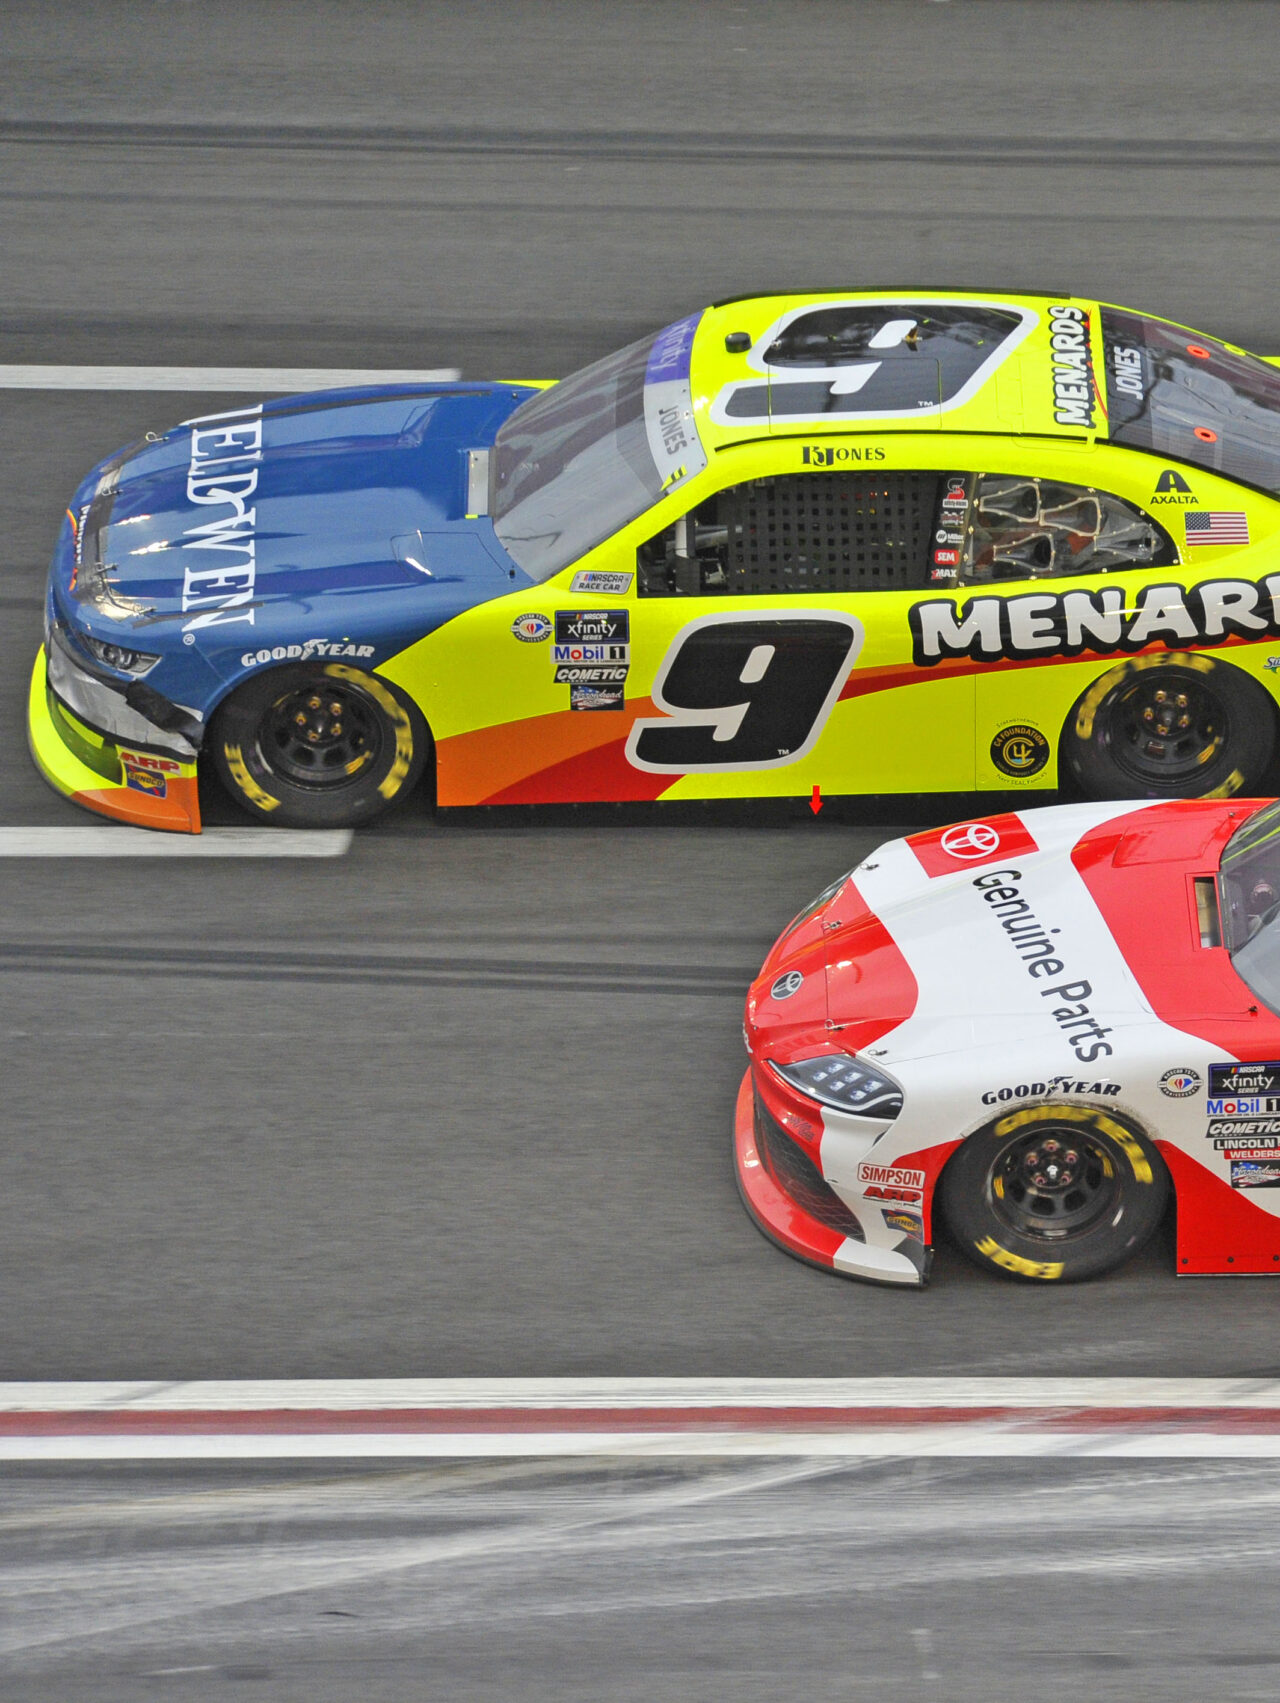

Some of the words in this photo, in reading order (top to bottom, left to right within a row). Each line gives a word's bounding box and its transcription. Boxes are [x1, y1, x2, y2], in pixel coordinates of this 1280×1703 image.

[711, 298, 1039, 425] 9
[1049, 306, 1094, 427] MENARDS
[1114, 346, 1143, 400] JONES
[658, 405, 687, 455] JONES
[1150, 496, 1199, 504] AXALTA
[938, 552, 955, 561] SEM
[590, 573, 624, 583] NASCAR
[603, 583, 620, 591] CAR
[568, 620, 617, 637] xfinity
[555, 646, 604, 660] Mobil
[557, 667, 627, 680] COMETIC
[627, 612, 863, 771] 9
[1001, 727, 1046, 746] FOUNDATION
[120, 752, 180, 772] ARP
[128, 772, 164, 787] SUNOCO
[972, 870, 1064, 978] Genuine
[1040, 979, 1113, 1063] Parts
[1222, 1074, 1274, 1090] xfinity
[1207, 1099, 1259, 1114] Mobil
[1216, 1139, 1275, 1149] LINCOLN
[1230, 1150, 1280, 1158] WELDERS
[861, 1166, 922, 1187] SIMPSON
[863, 1186, 922, 1202] ARP
